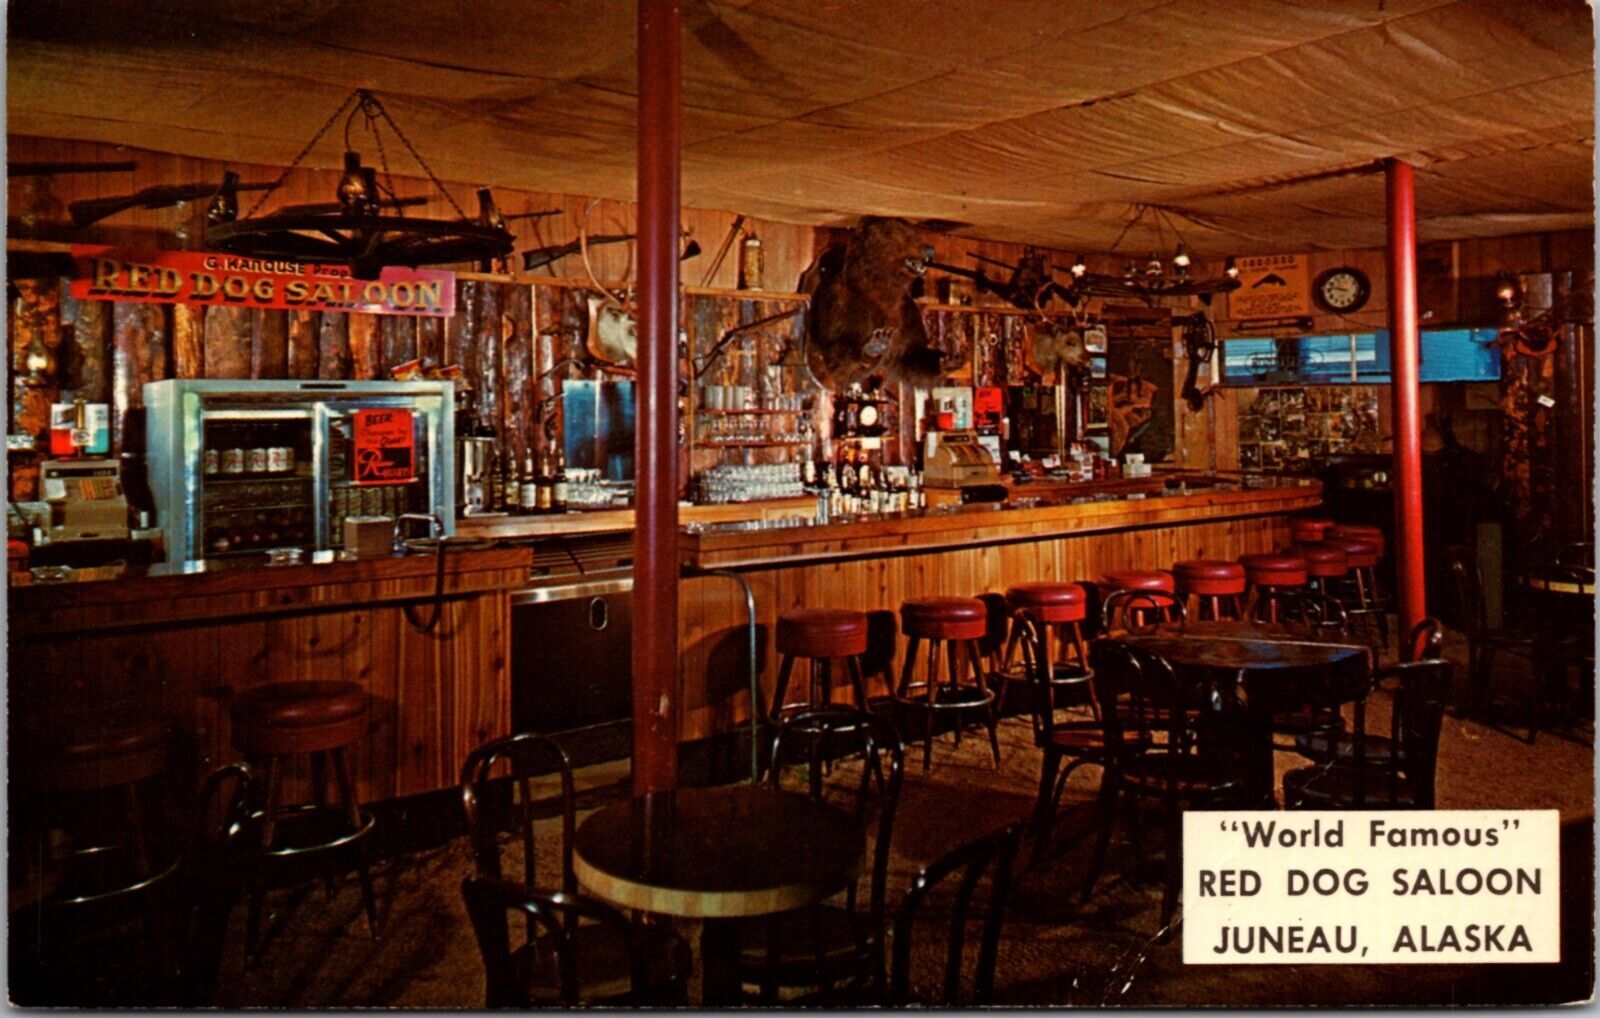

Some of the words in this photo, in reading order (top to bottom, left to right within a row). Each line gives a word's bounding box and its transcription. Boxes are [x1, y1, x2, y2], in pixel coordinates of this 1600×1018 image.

[88, 256, 183, 298] RED
[188, 271, 275, 303] DOG
[284, 278, 444, 312] SALOON
